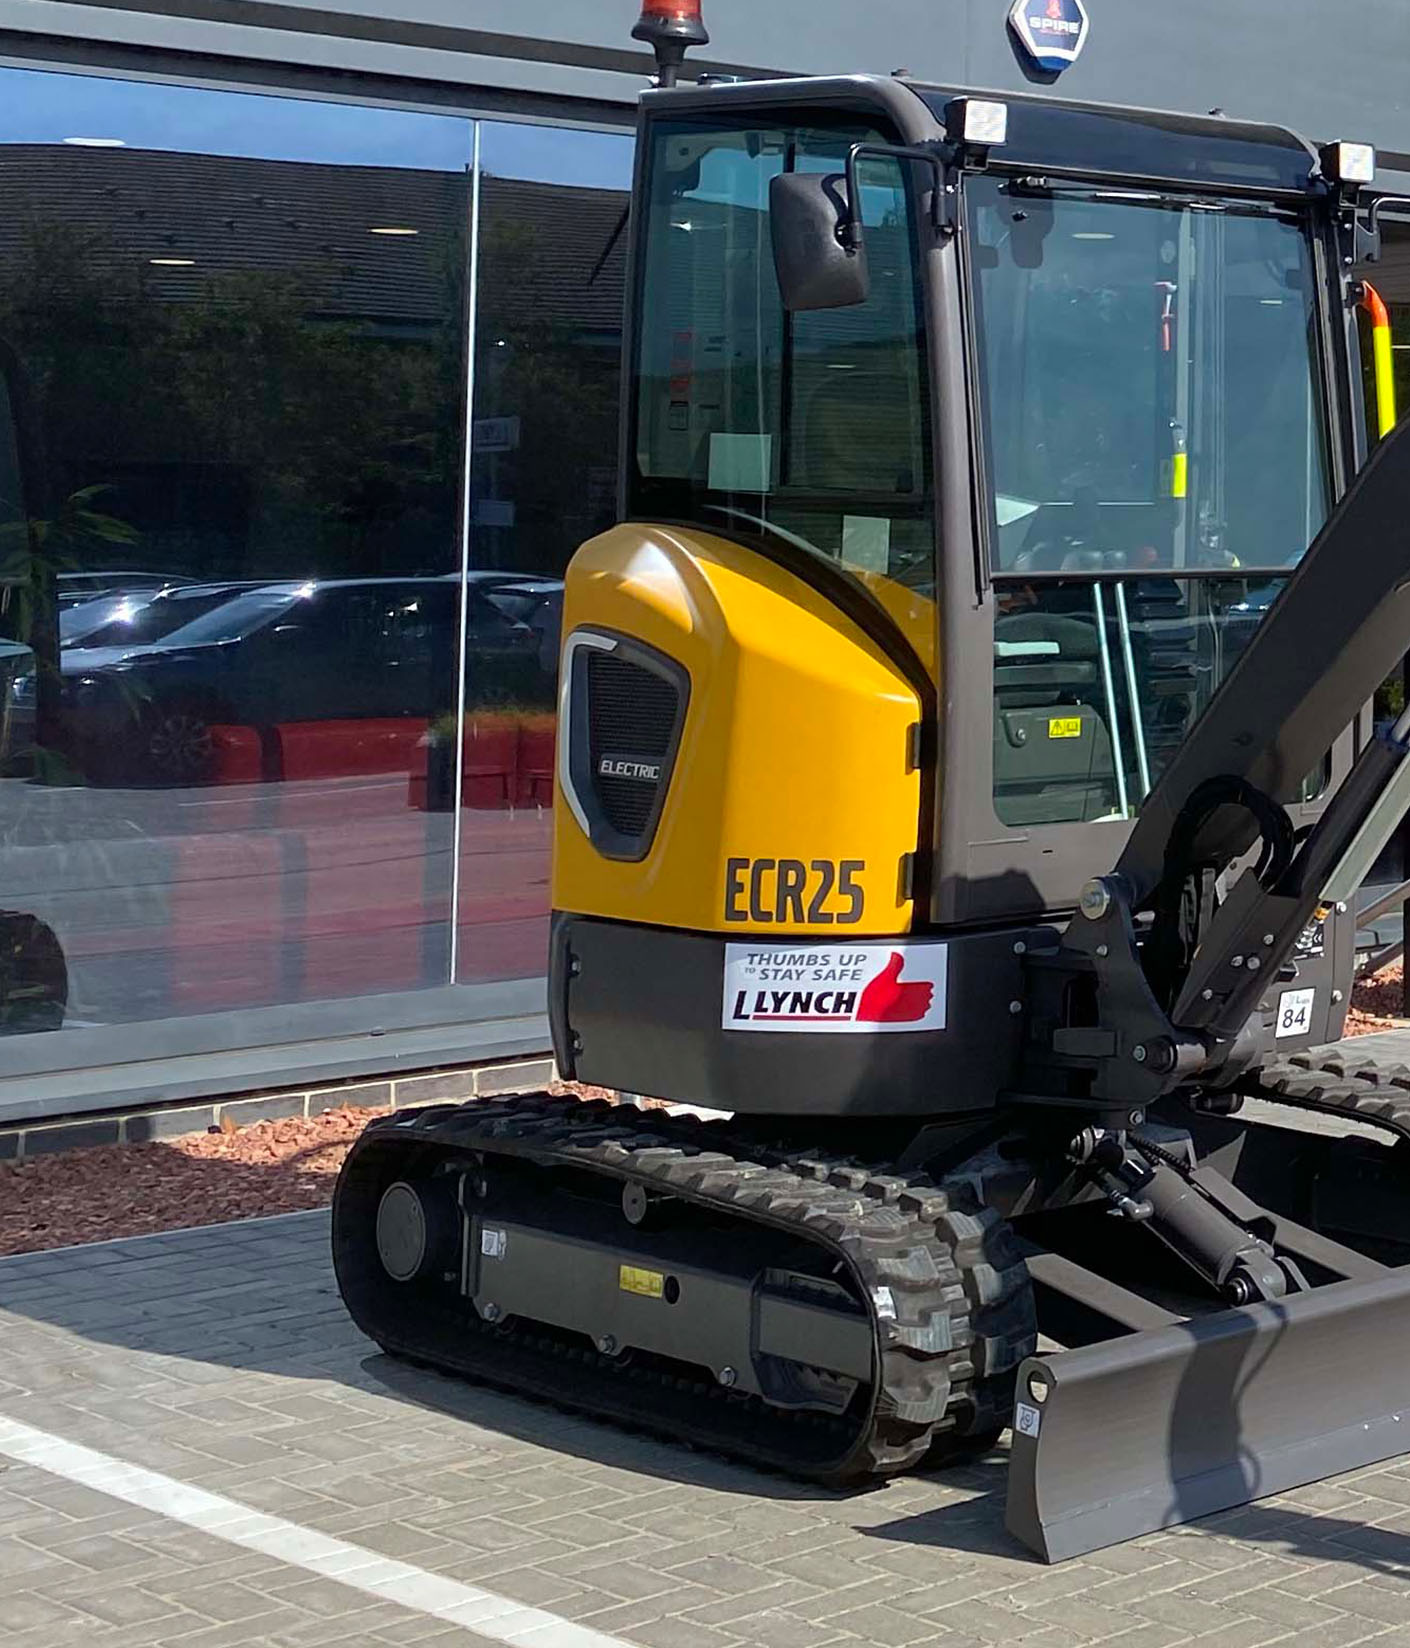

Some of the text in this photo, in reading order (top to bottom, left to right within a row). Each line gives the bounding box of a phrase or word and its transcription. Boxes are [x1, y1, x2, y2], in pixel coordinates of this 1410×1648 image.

[1029, 16, 1081, 34] SPIRE
[600, 759, 660, 780] ELECTRIC
[725, 857, 866, 924] ECR25
[746, 952, 868, 967] THUMBS UP
[758, 967, 807, 981] STAY
[811, 968, 864, 982] SAFE
[1282, 1006, 1306, 1029] 84
